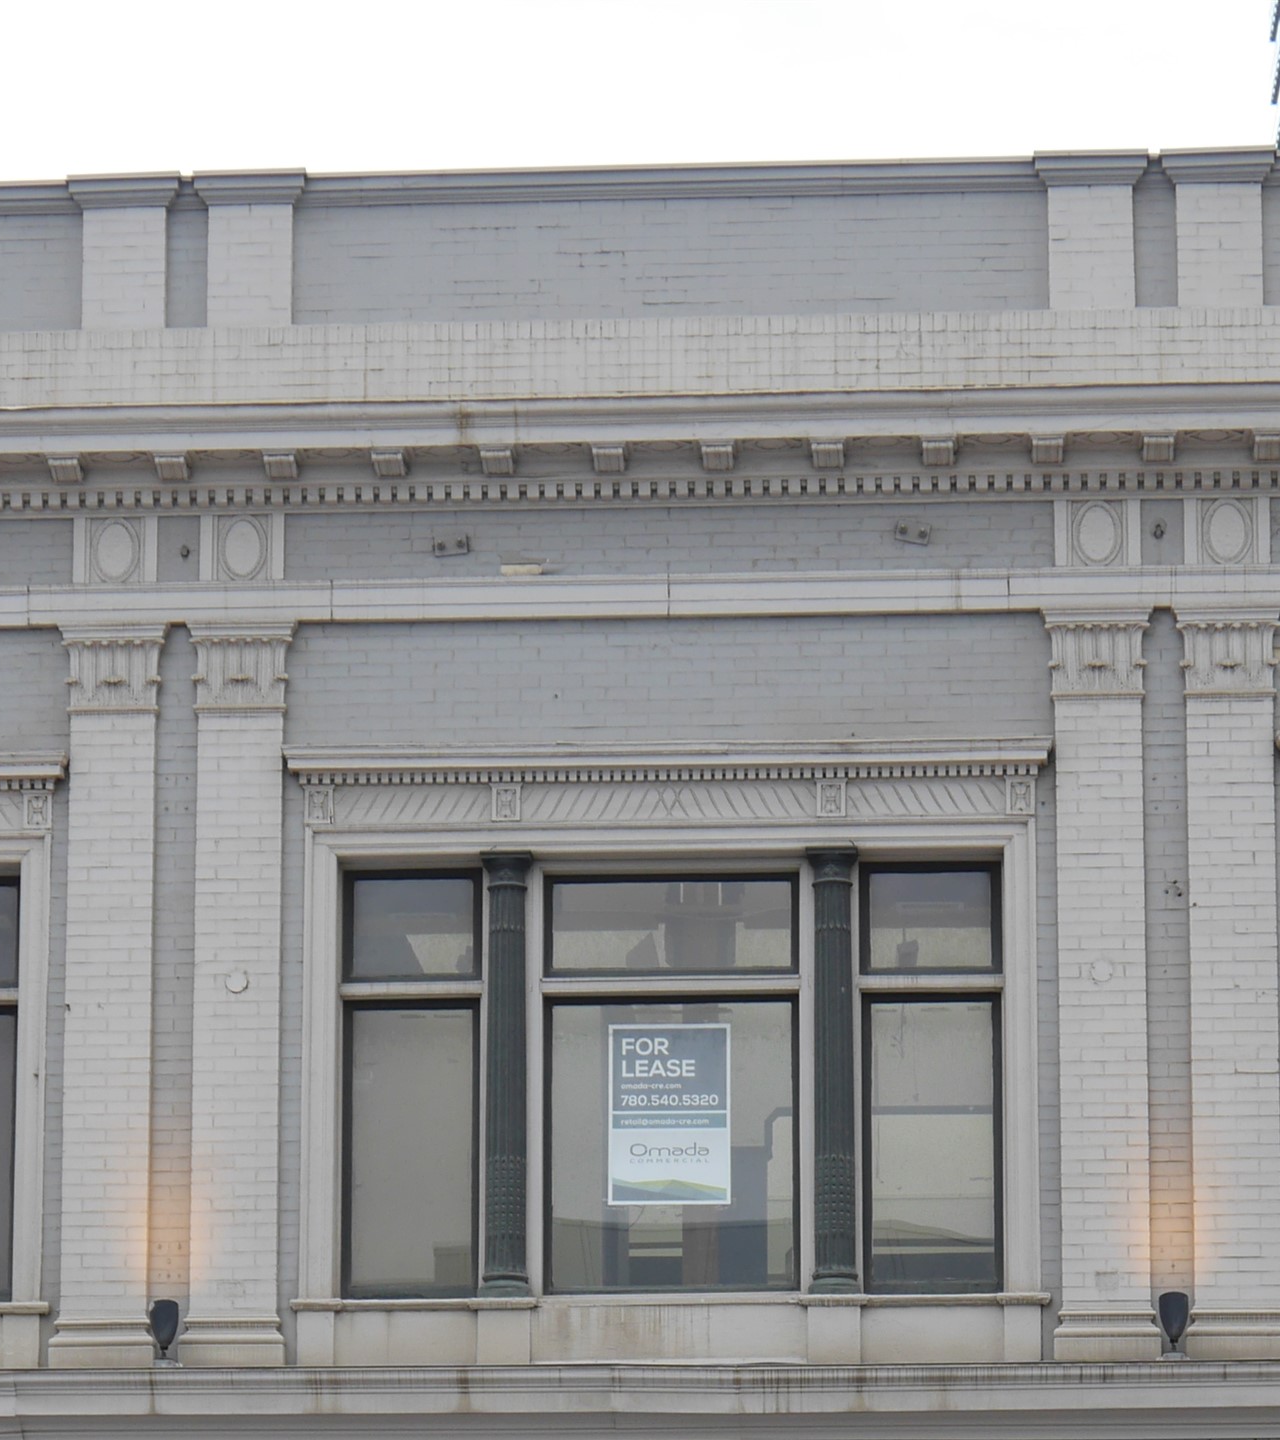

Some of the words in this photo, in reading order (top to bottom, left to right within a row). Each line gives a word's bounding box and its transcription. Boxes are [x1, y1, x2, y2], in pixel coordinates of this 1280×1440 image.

[621, 1037, 670, 1056] FOR
[620, 1059, 696, 1078] LEASE
[620, 1094, 719, 1107] 780.540.5320
[629, 1141, 710, 1157] Omada
